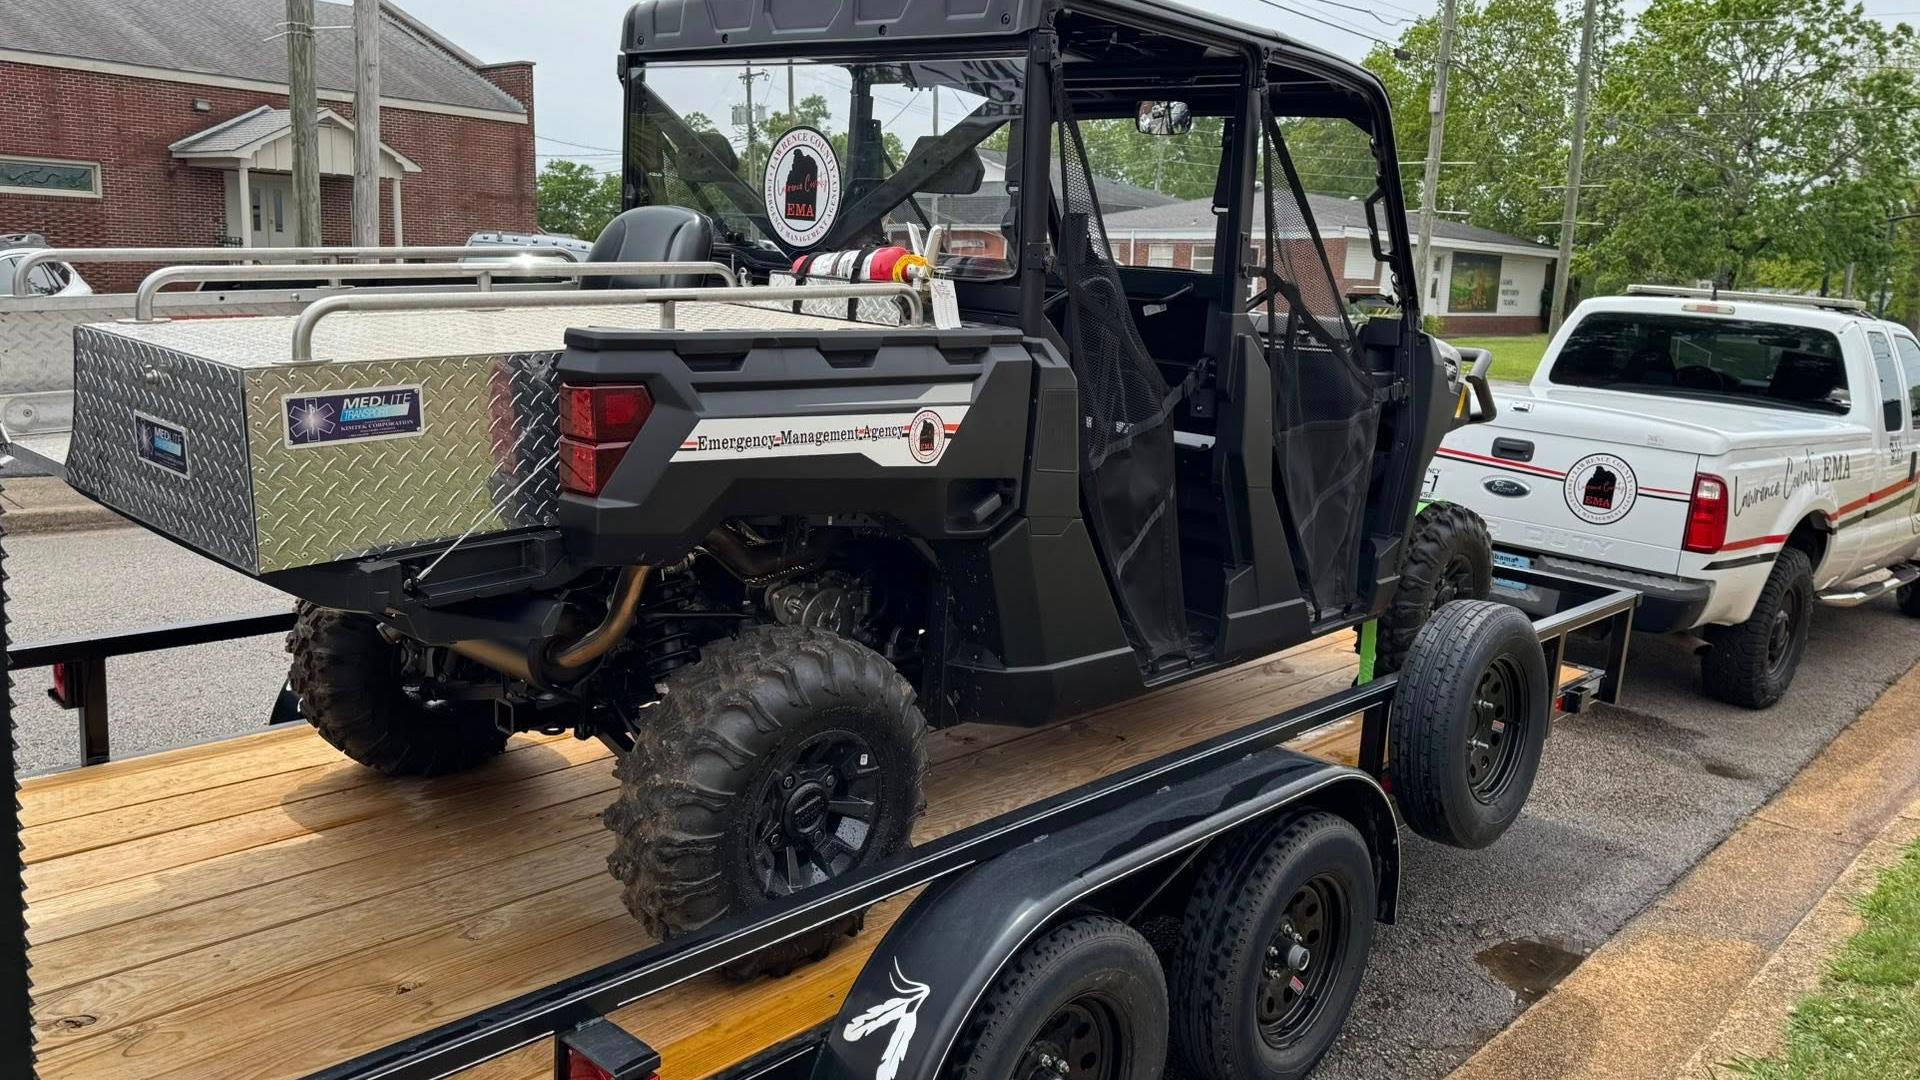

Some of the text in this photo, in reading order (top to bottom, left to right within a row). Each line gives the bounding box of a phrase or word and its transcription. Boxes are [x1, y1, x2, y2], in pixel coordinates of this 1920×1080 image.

[770, 132, 837, 172] LAWRENCE COUNTY
[766, 179, 838, 242] EMERGENCY MANAGEMENT AGENCY
[786, 203, 815, 217] EMA
[343, 392, 412, 410] MEDLITE
[368, 419, 414, 429] CORPORATION
[697, 425, 904, 452] Emergency Management Agency
[1573, 457, 1633, 484] LAWRENCE COUNTY
[1490, 478, 1519, 495] Ford
[1734, 448, 1851, 517] Lawrence County EMA
[1585, 496, 1610, 507] EMA
[1582, 509, 1622, 521] MANAGEMENT
[1522, 525, 1615, 556] DUTY
[1494, 552, 1516, 563] bama
